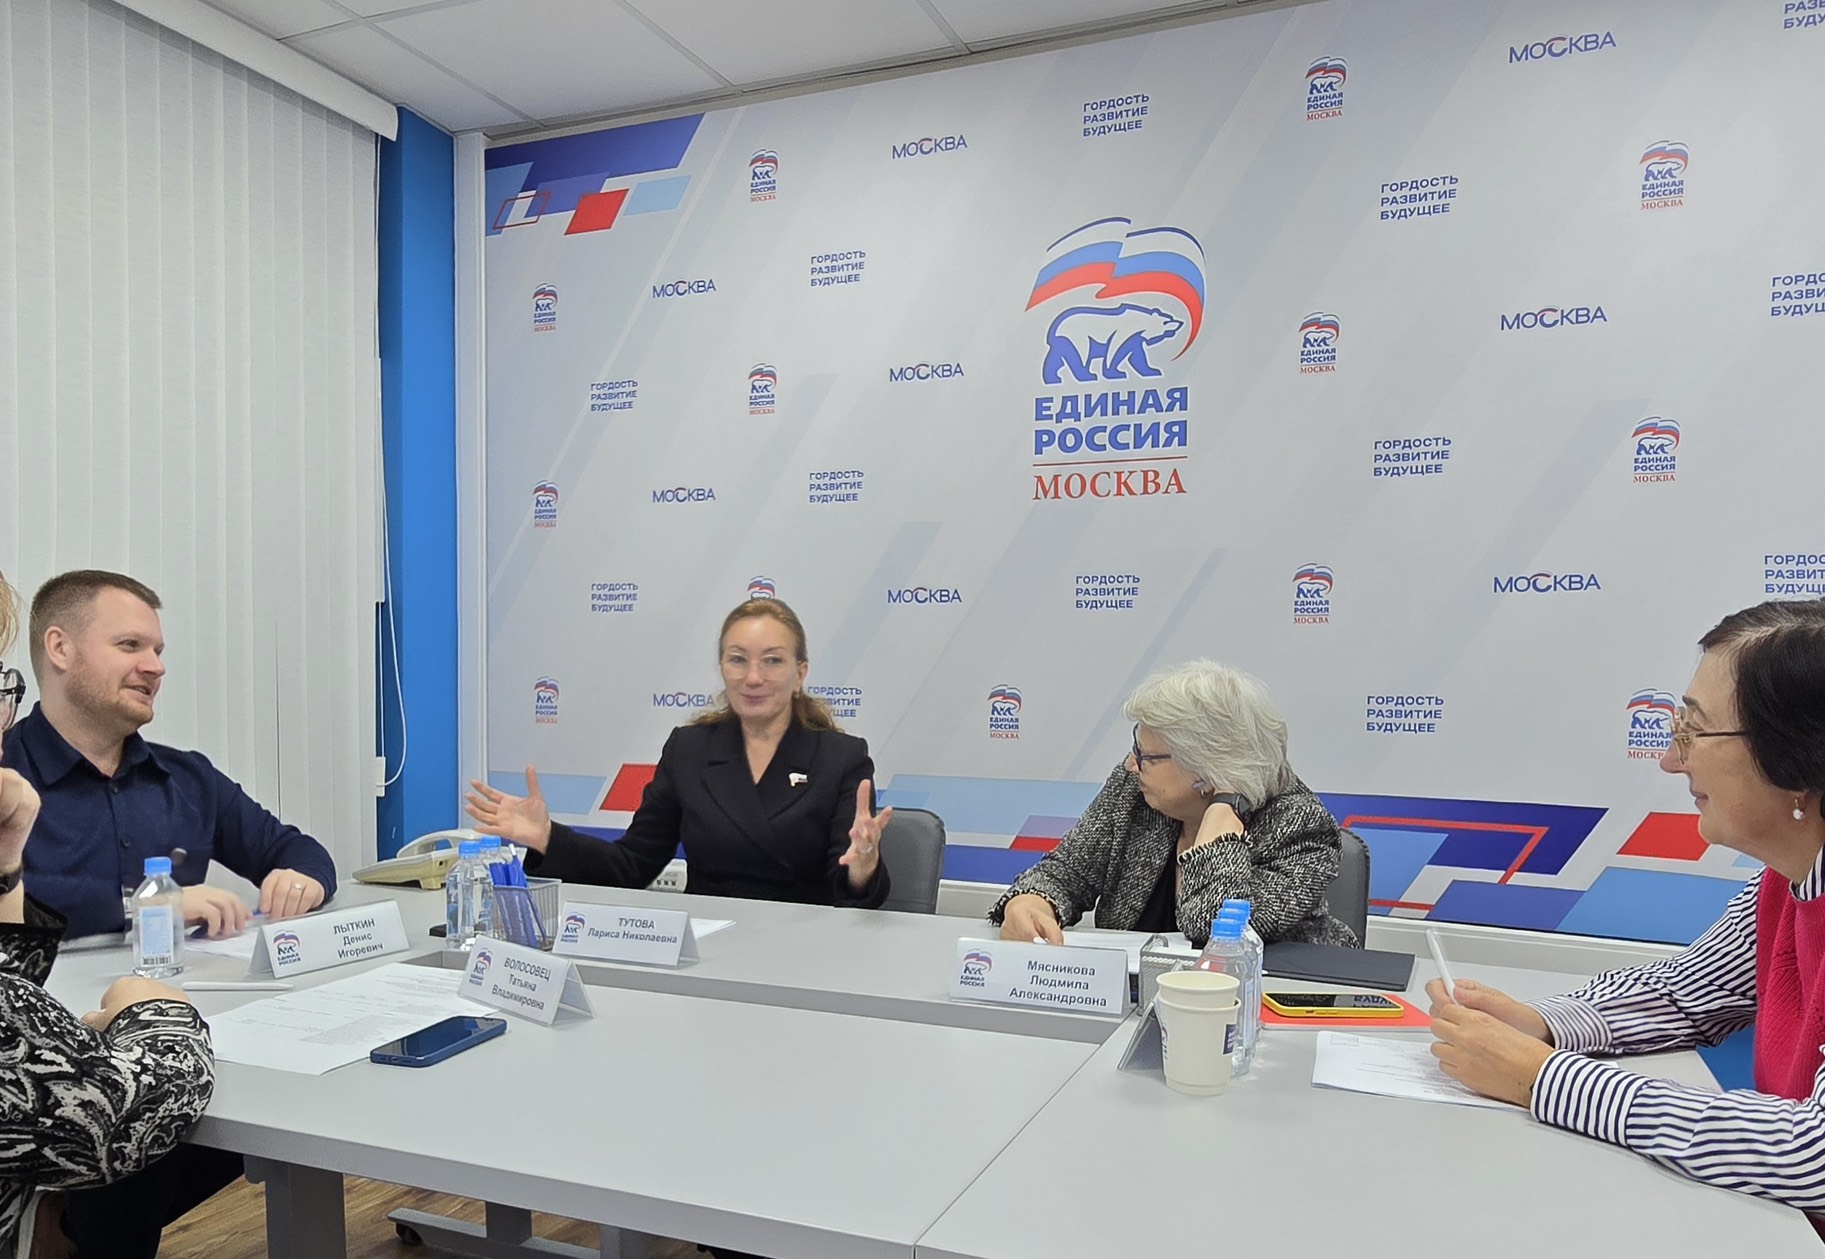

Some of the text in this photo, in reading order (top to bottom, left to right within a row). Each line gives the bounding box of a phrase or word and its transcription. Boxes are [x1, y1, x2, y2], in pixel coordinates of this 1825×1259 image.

[1509, 31, 1617, 64] МОСКВА
[1083, 93, 1150, 113] ГОРДОСТЬ
[1307, 92, 1344, 103] ЕДИНАЯ
[1307, 99, 1343, 111] РОССИЯ
[1083, 106, 1148, 125] РАЗВИТИЕ
[1306, 110, 1343, 121] МОСКВА
[1083, 119, 1143, 137] БУДУЩЕЕ
[892, 134, 968, 160] МОСКВА
[750, 179, 776, 188] ЕДИНАЯ
[750, 185, 776, 194] РОССИЯ
[1381, 175, 1459, 194] ГОРДОСТЬ
[1641, 179, 1684, 191] ЕДИНАЯ
[1380, 188, 1457, 207] РАЗВИТИЕ
[1641, 187, 1684, 199] РОССИЯ
[1640, 198, 1684, 210] МОСКВА
[1380, 202, 1450, 220] БУДУЩЕЕ
[810, 250, 866, 265] ГОРДОСТЬ
[810, 261, 865, 276] РАЗВИТИЕ
[810, 273, 861, 287] БУДУЩЕЕ
[652, 278, 717, 299] МОСКВА
[1500, 306, 1608, 331] МОСКВА
[1300, 347, 1336, 357] ЕДИНАЯ
[1300, 354, 1336, 364] РОССИЯ
[889, 362, 965, 382] МОСКВА
[1299, 365, 1336, 374] МОСКВА
[590, 380, 638, 391] ГОРДОСТЬ
[590, 390, 637, 401] РАЗВИТИЕ
[590, 401, 633, 412] БУДУЩЕЕ
[1034, 386, 1188, 424] ЕДИНАЯ
[1034, 419, 1188, 455] РОССИЯ
[1374, 436, 1452, 451] ГОРДОСТЬ
[1374, 450, 1450, 464] РАЗВИТИЕ
[1634, 455, 1676, 465] ЕДИНАЯ
[1373, 463, 1443, 478] БУДУЩЕЕ
[1633, 463, 1676, 472] РОССИЯ
[809, 470, 864, 481] ГОРДОСТЬ
[1633, 474, 1676, 483] МОСКВА
[809, 481, 863, 492] РАЗВИТИЕ
[1032, 468, 1188, 501] МОСКВА
[652, 487, 716, 503] МОСКВА
[809, 492, 858, 504] БУДУЩЕЕ
[1076, 574, 1140, 586] ГОРДОСТЬ
[1765, 569, 1825, 580] РАЗВИТ
[591, 583, 638, 592] ГОРДОСТЬ
[1493, 573, 1601, 593] МОСКВА
[591, 593, 637, 602] РАЗВИТИЕ
[887, 587, 962, 604] МОСКВА
[1075, 587, 1139, 597] РАЗВИТИЕ
[591, 604, 634, 613] БУДУЩЕЕ
[1075, 599, 1133, 610] БУДУЩЕЕ
[808, 686, 862, 696] ГОРДОСТЬ
[653, 692, 714, 707] МОСКВА
[1367, 695, 1444, 707] ГОРДОСТЬ
[1366, 708, 1442, 719] РАЗВИТИЕ
[1366, 722, 1436, 734] БУДУЩЕЕ
[1628, 731, 1672, 739] ЕДИНАЯ
[334, 918, 375, 934] ЛЫТКИН
[618, 918, 655, 929] ТУТОВА
[343, 933, 372, 946] Денис
[588, 928, 620, 939] Лариса
[622, 931, 678, 943] Николаевна
[338, 943, 383, 958] Игоревич
[504, 957, 551, 982] ВОЛОСОВЕЦ
[1027, 960, 1096, 976] Мясникова
[509, 974, 537, 992] Татьяна
[1030, 975, 1089, 990] Людмила
[492, 984, 545, 1010] Владимировна
[1009, 987, 1107, 1007] Александровна
